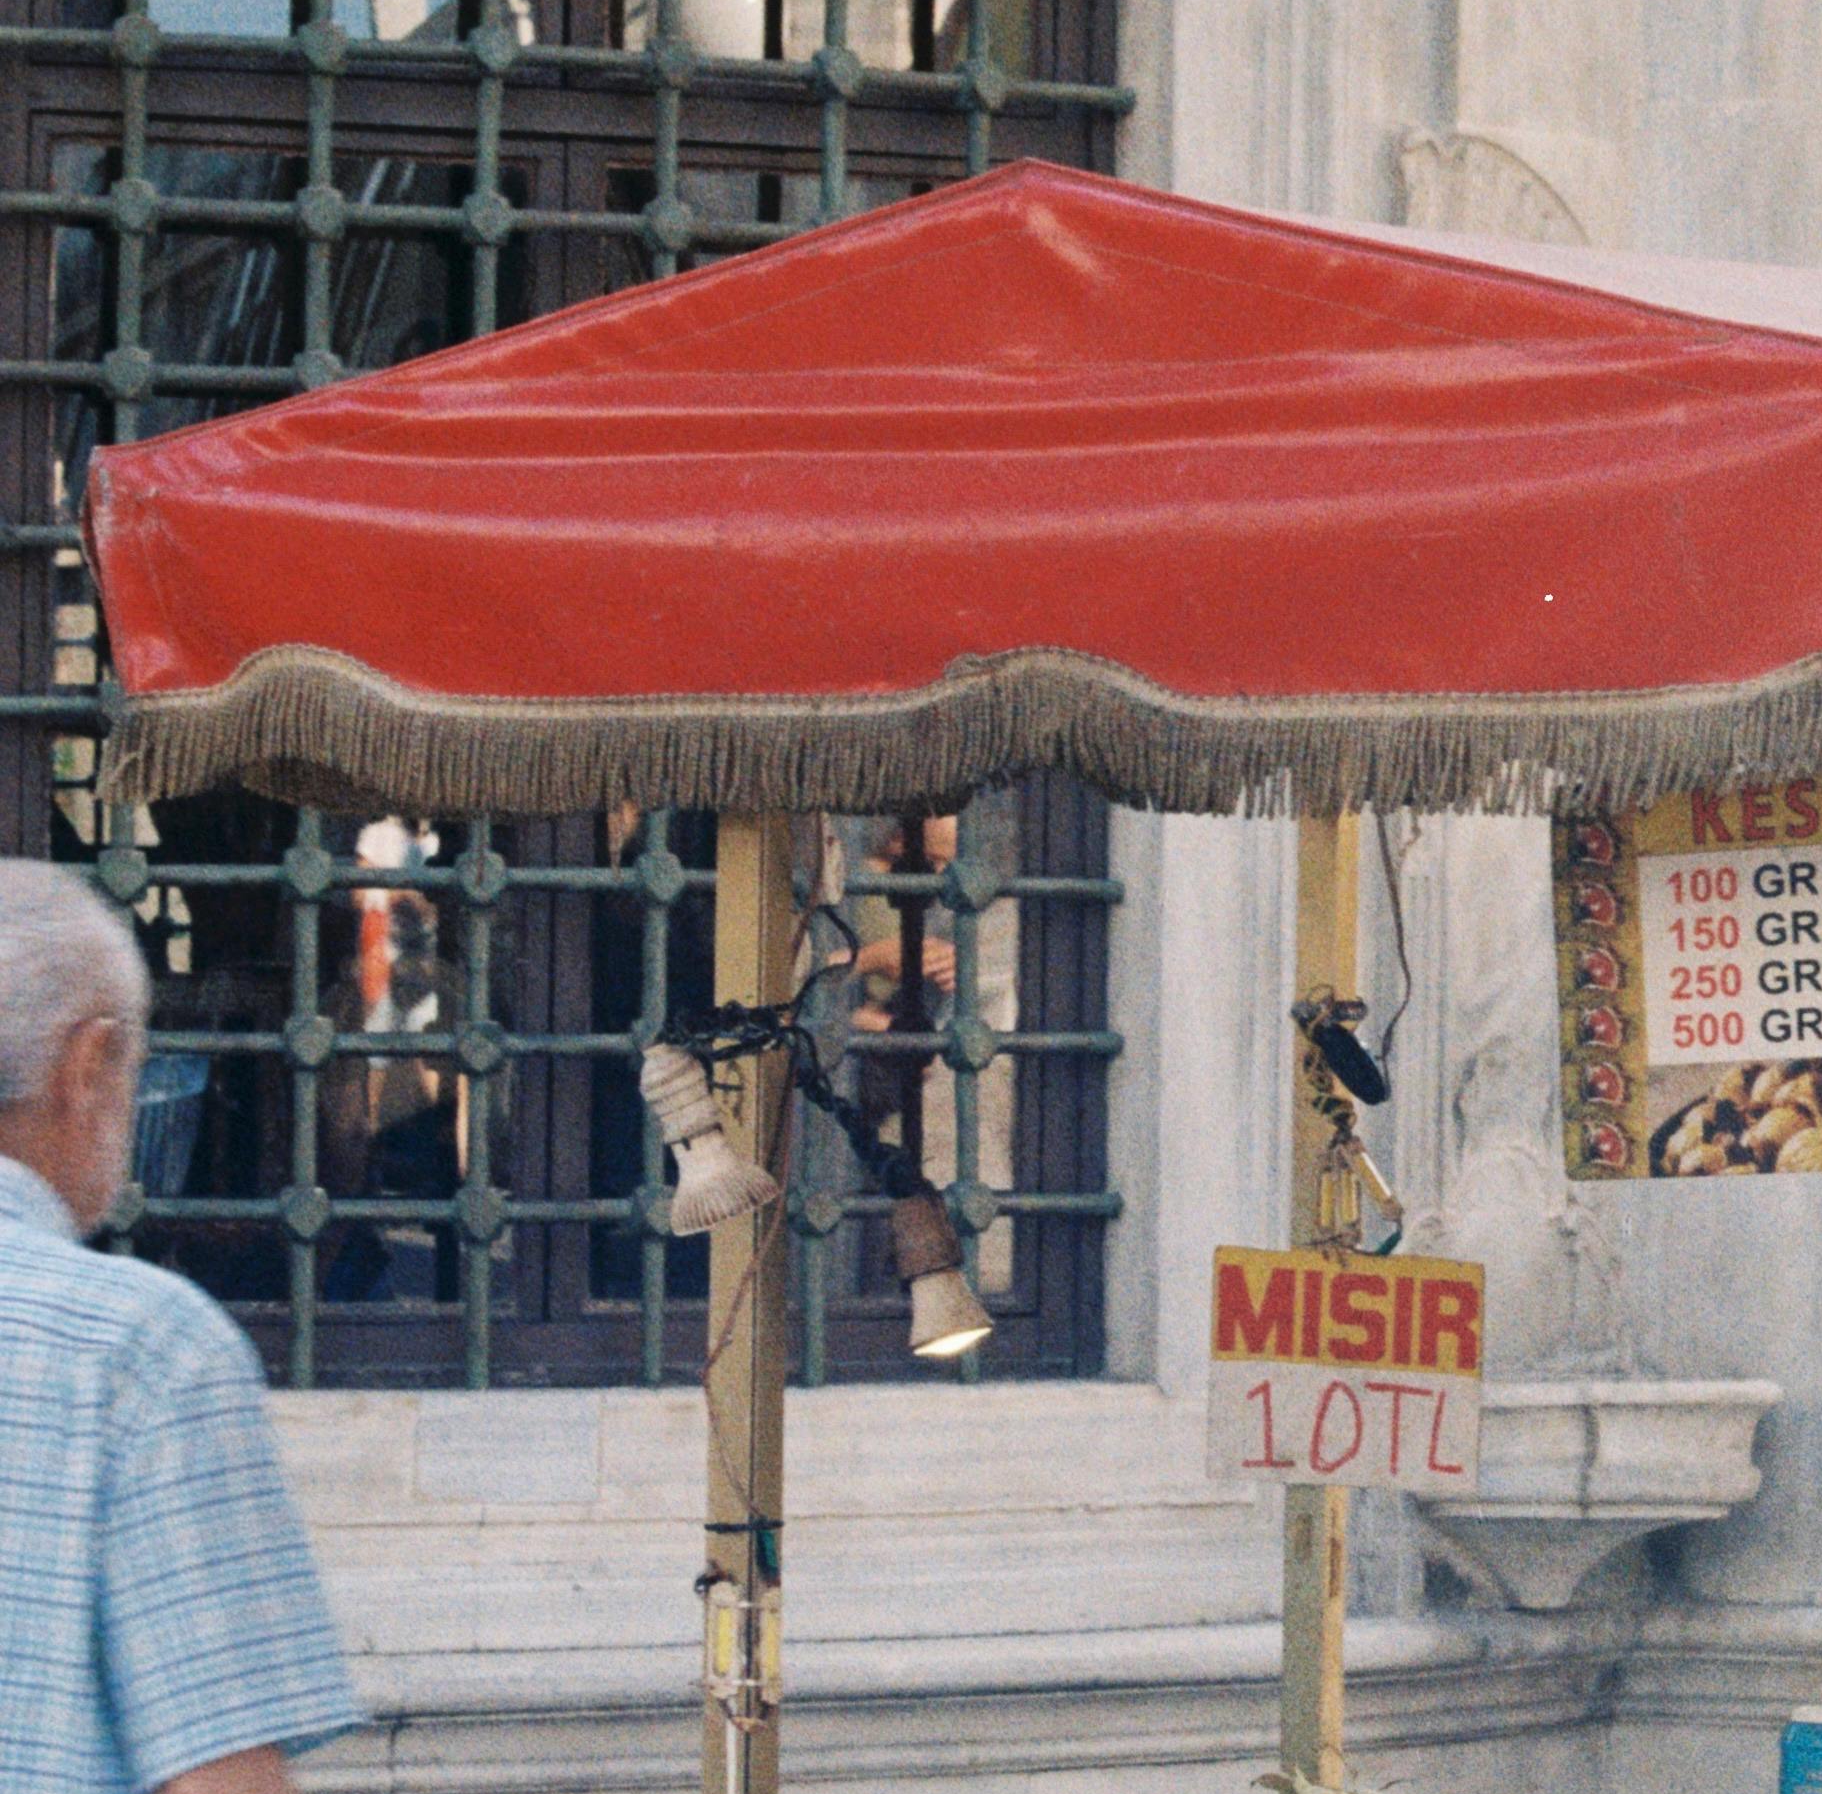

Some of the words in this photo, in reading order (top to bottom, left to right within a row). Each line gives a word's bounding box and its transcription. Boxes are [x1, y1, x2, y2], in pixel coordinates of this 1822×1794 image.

[1667, 866, 1738, 905] 100
[1752, 861, 1819, 899] GR
[1668, 915, 1740, 953] 150
[1755, 910, 1822, 947] GR
[1669, 964, 1742, 1002] 250
[1672, 1011, 1745, 1049] 500
[1215, 1263, 1480, 1370] MISIR
[1241, 1379, 1464, 1476] 10TL
